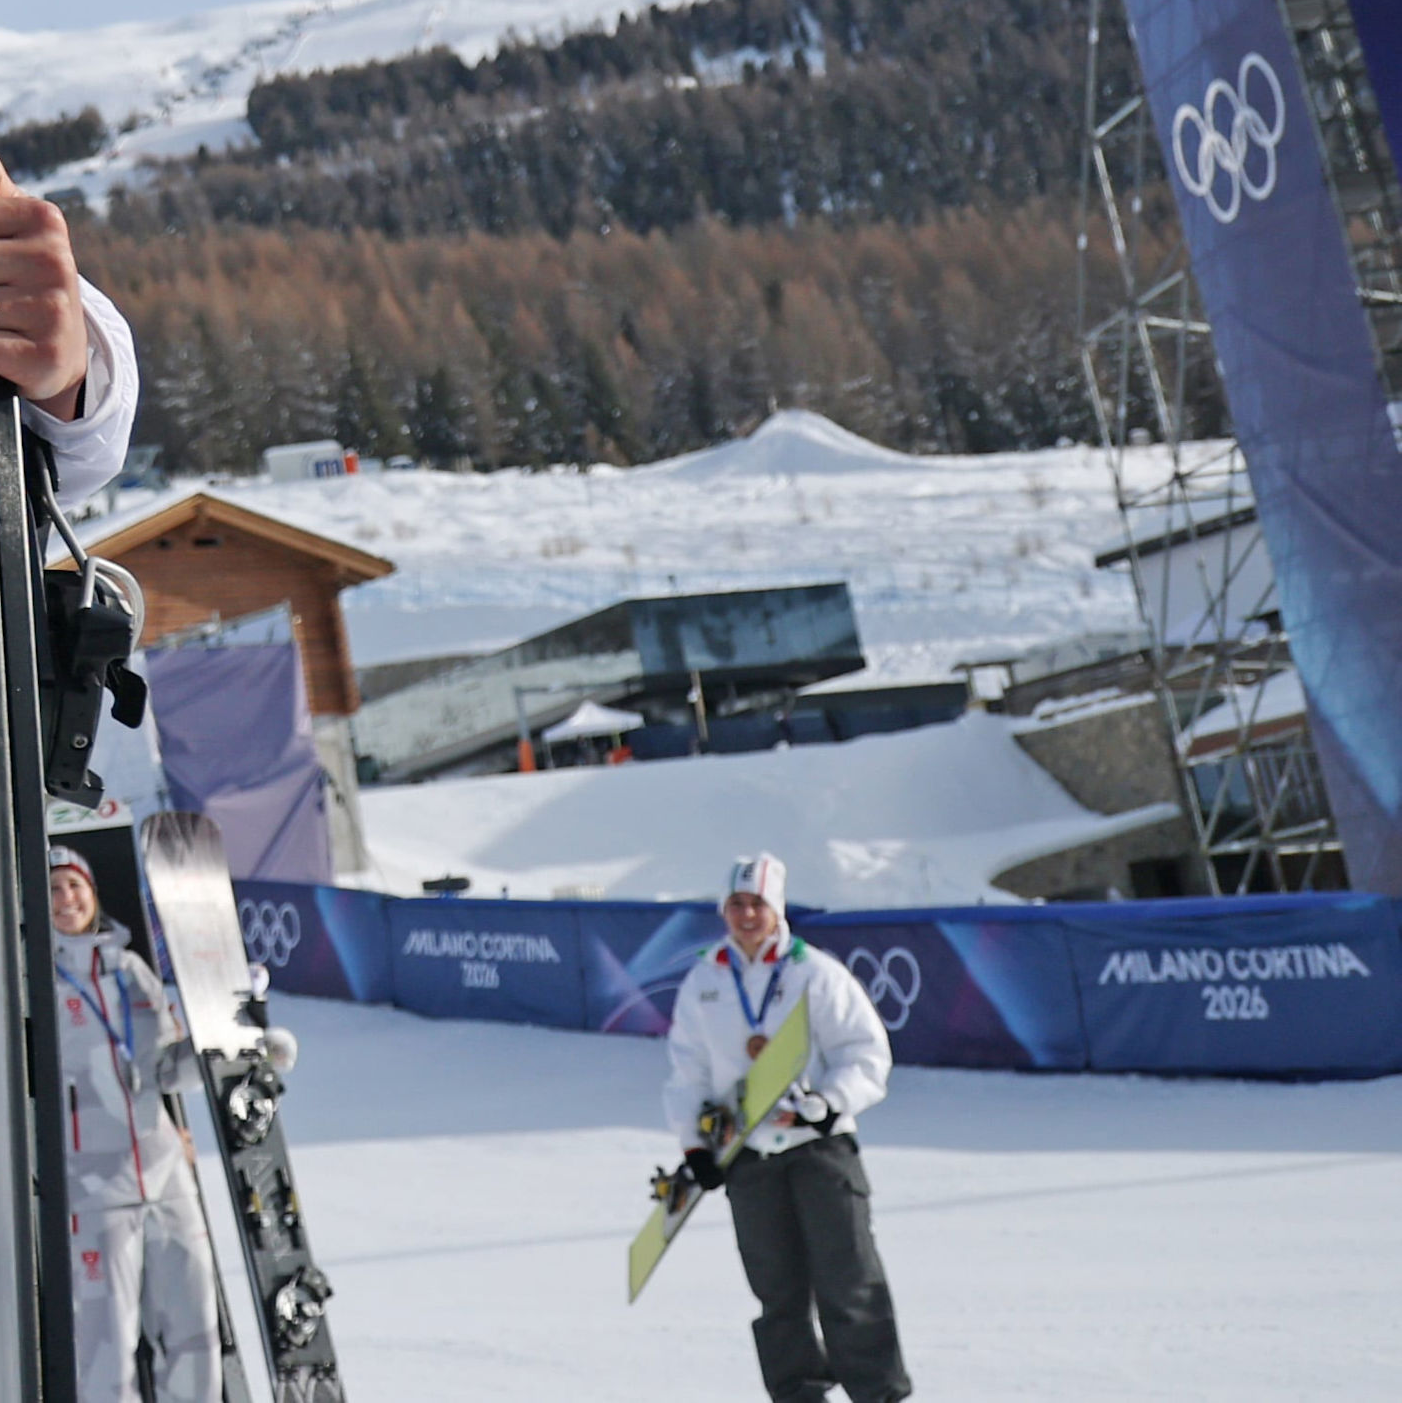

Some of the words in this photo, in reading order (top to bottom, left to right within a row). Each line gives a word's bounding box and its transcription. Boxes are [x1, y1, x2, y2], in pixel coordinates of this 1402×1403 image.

[1098, 948, 1224, 985] MILANO
[1226, 942, 1371, 980] CORTINA
[1201, 985, 1269, 1019] 2026
